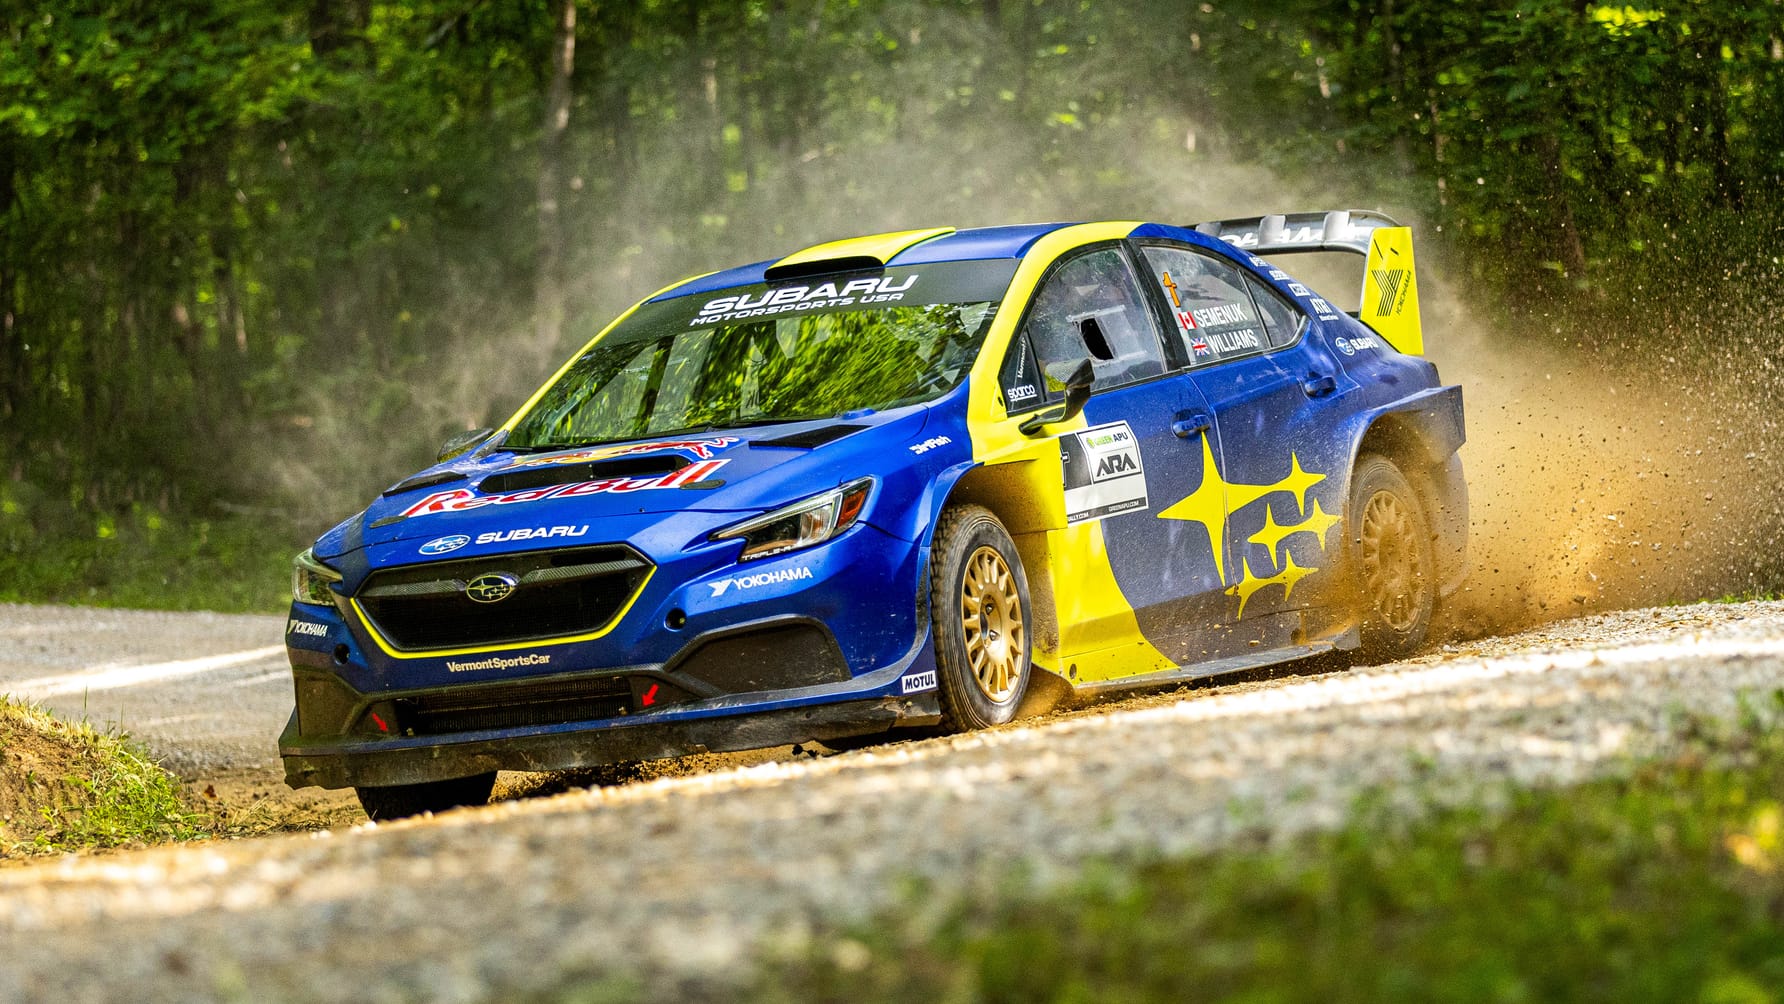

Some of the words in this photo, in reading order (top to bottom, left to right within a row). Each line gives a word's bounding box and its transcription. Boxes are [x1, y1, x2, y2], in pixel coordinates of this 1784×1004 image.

[698, 274, 919, 316] SUBARU
[689, 297, 852, 327] MOTORSPORTS
[859, 292, 905, 304] USA
[1193, 302, 1248, 329] SEMENUK
[1205, 329, 1259, 355] WILLIAMS
[1349, 337, 1379, 351] SUBARU
[1007, 384, 1036, 402] sparco
[1094, 435, 1113, 446] GREEN
[1112, 431, 1129, 443] APU
[1096, 453, 1137, 477] ARA
[400, 484, 567, 517] Red
[547, 459, 731, 499] Bull
[475, 524, 589, 545] SUBARU
[733, 566, 814, 591] YOKOHAMA
[294, 620, 329, 638] YOKOHAMA
[446, 653, 551, 673] VermontSportsCar
[904, 673, 936, 691] MOTUL
